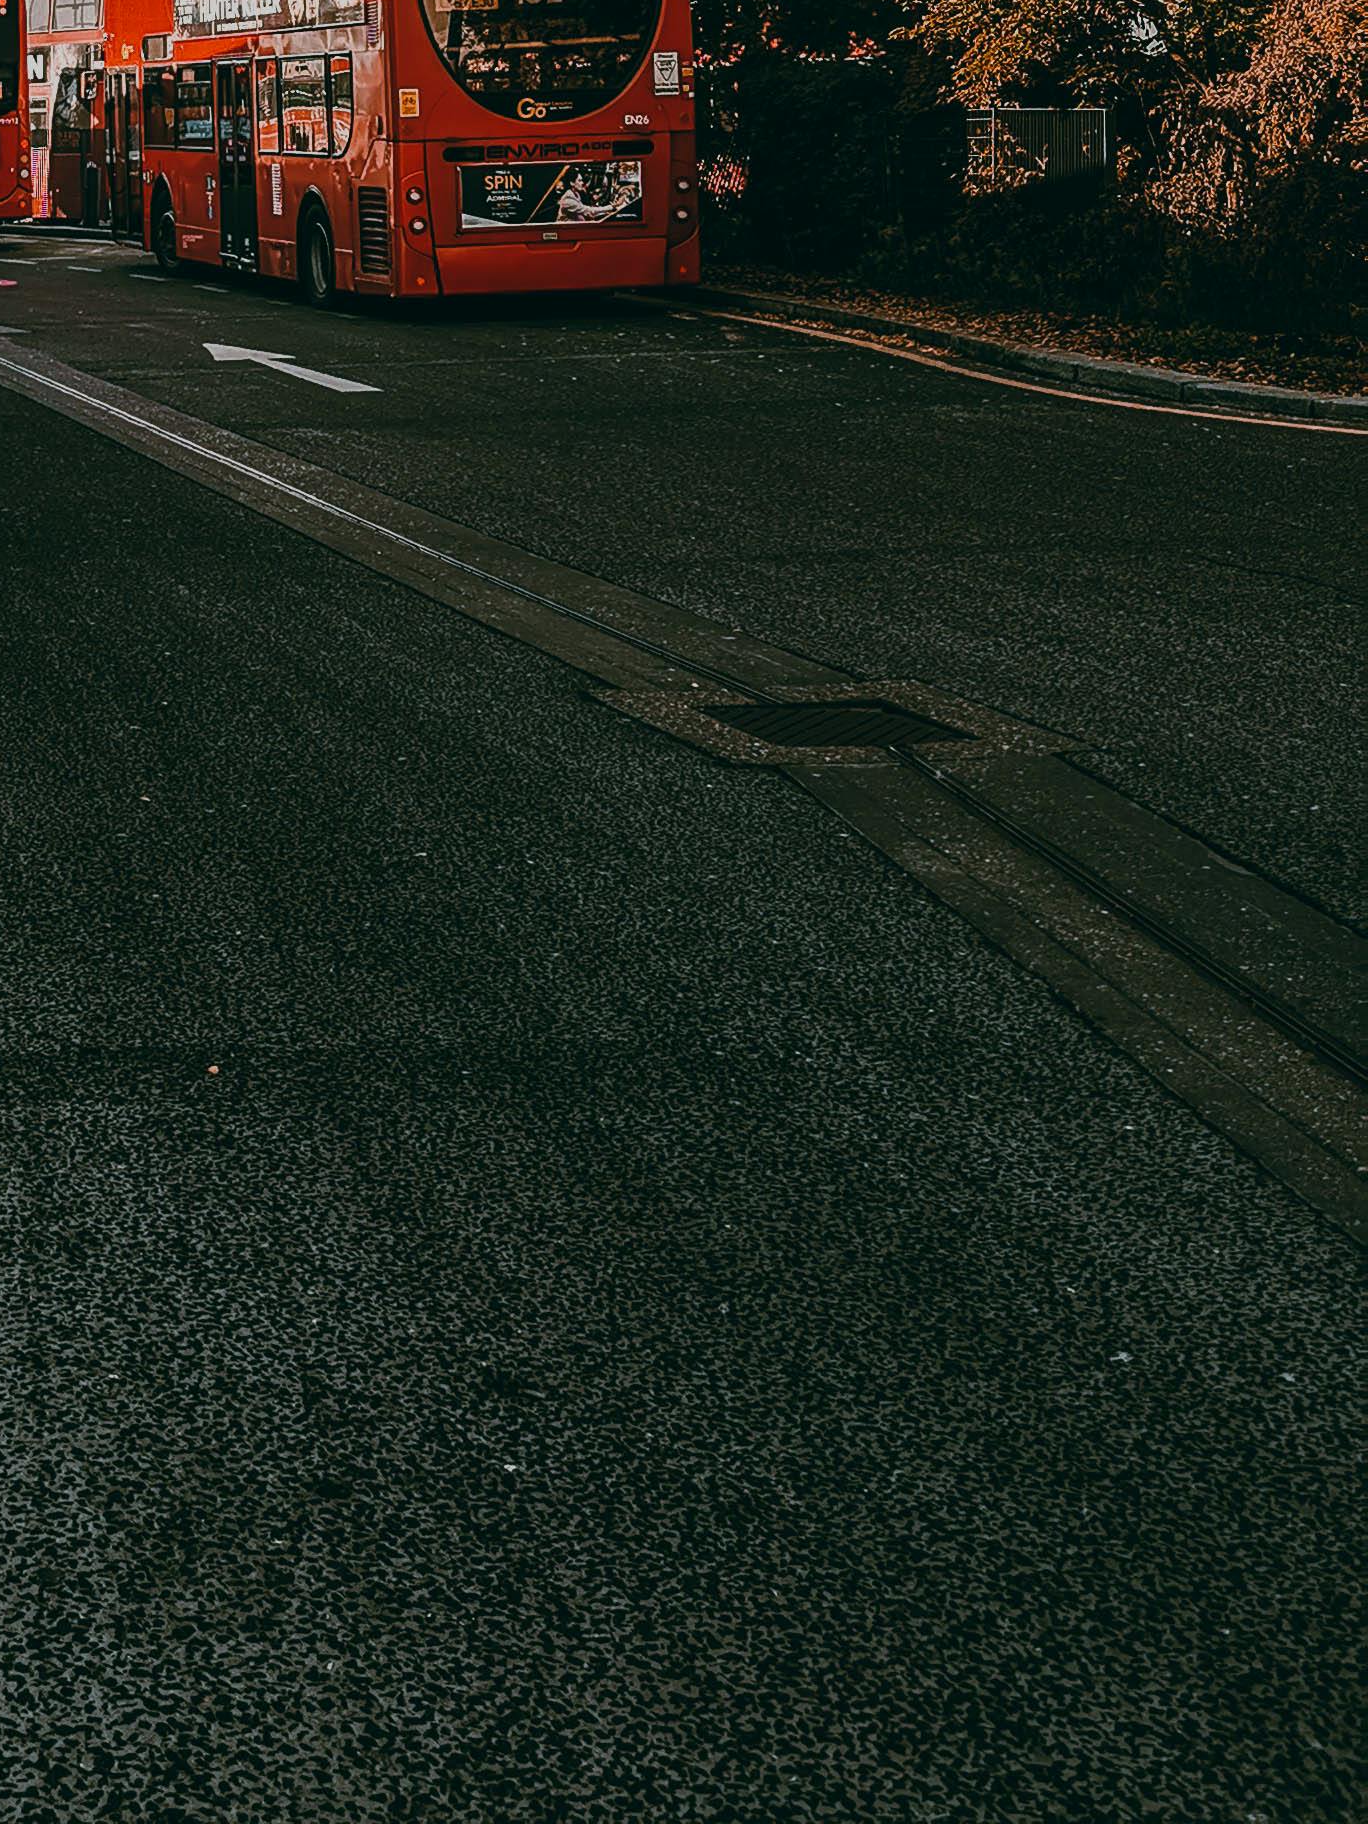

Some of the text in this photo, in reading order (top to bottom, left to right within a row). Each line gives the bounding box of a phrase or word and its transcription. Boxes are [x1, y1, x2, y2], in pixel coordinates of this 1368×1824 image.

[624, 114, 650, 125] EN26
[487, 143, 579, 159] ENVIRO
[484, 175, 523, 190] SPIN
